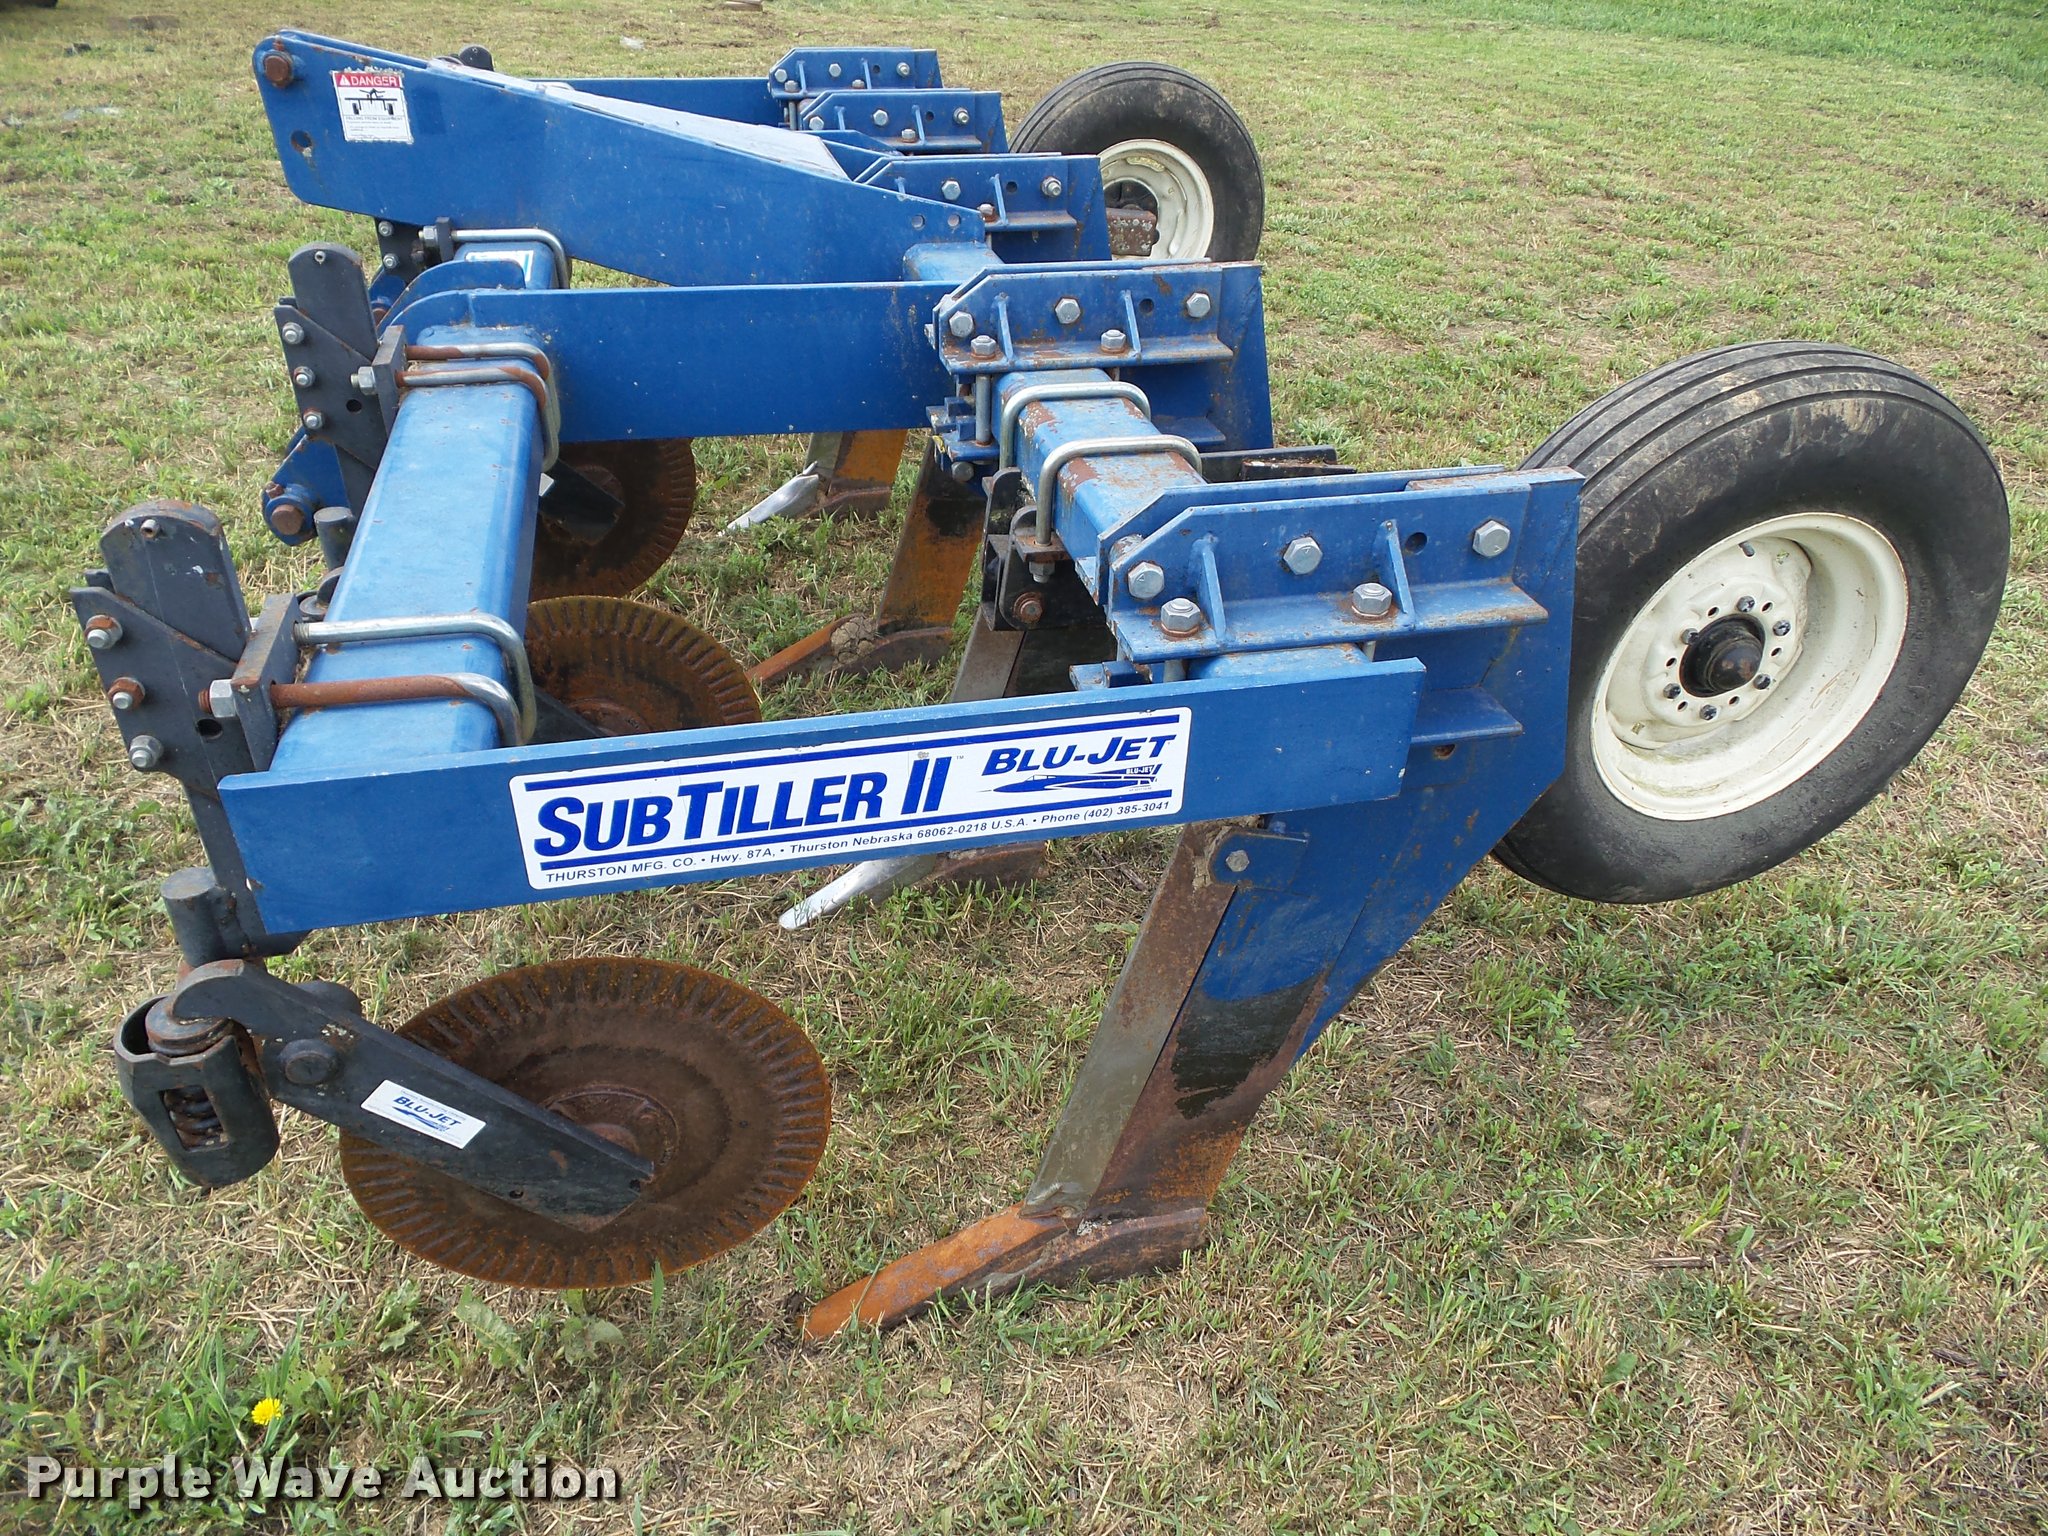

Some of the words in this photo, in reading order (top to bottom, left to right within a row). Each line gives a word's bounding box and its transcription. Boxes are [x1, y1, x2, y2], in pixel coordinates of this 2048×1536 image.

[351, 76, 398, 87] DANGER
[981, 734, 1177, 776] BLU-JET
[1125, 765, 1154, 775] BLU-JET
[545, 864, 628, 883] THURSTON
[631, 860, 668, 873] MFG.
[672, 857, 698, 868] CO.
[710, 852, 742, 864] Hwy.
[747, 848, 776, 859] 87A,
[790, 838, 849, 854] Thurston
[852, 831, 913, 847] Nebraska
[917, 822, 988, 840] 68062-0218
[991, 816, 1029, 830] U.S.A.
[1041, 810, 1081, 824] Phone
[1083, 806, 1114, 821] (402)
[1116, 800, 1170, 816] 385-3041
[393, 1096, 462, 1126] BLU-JET
